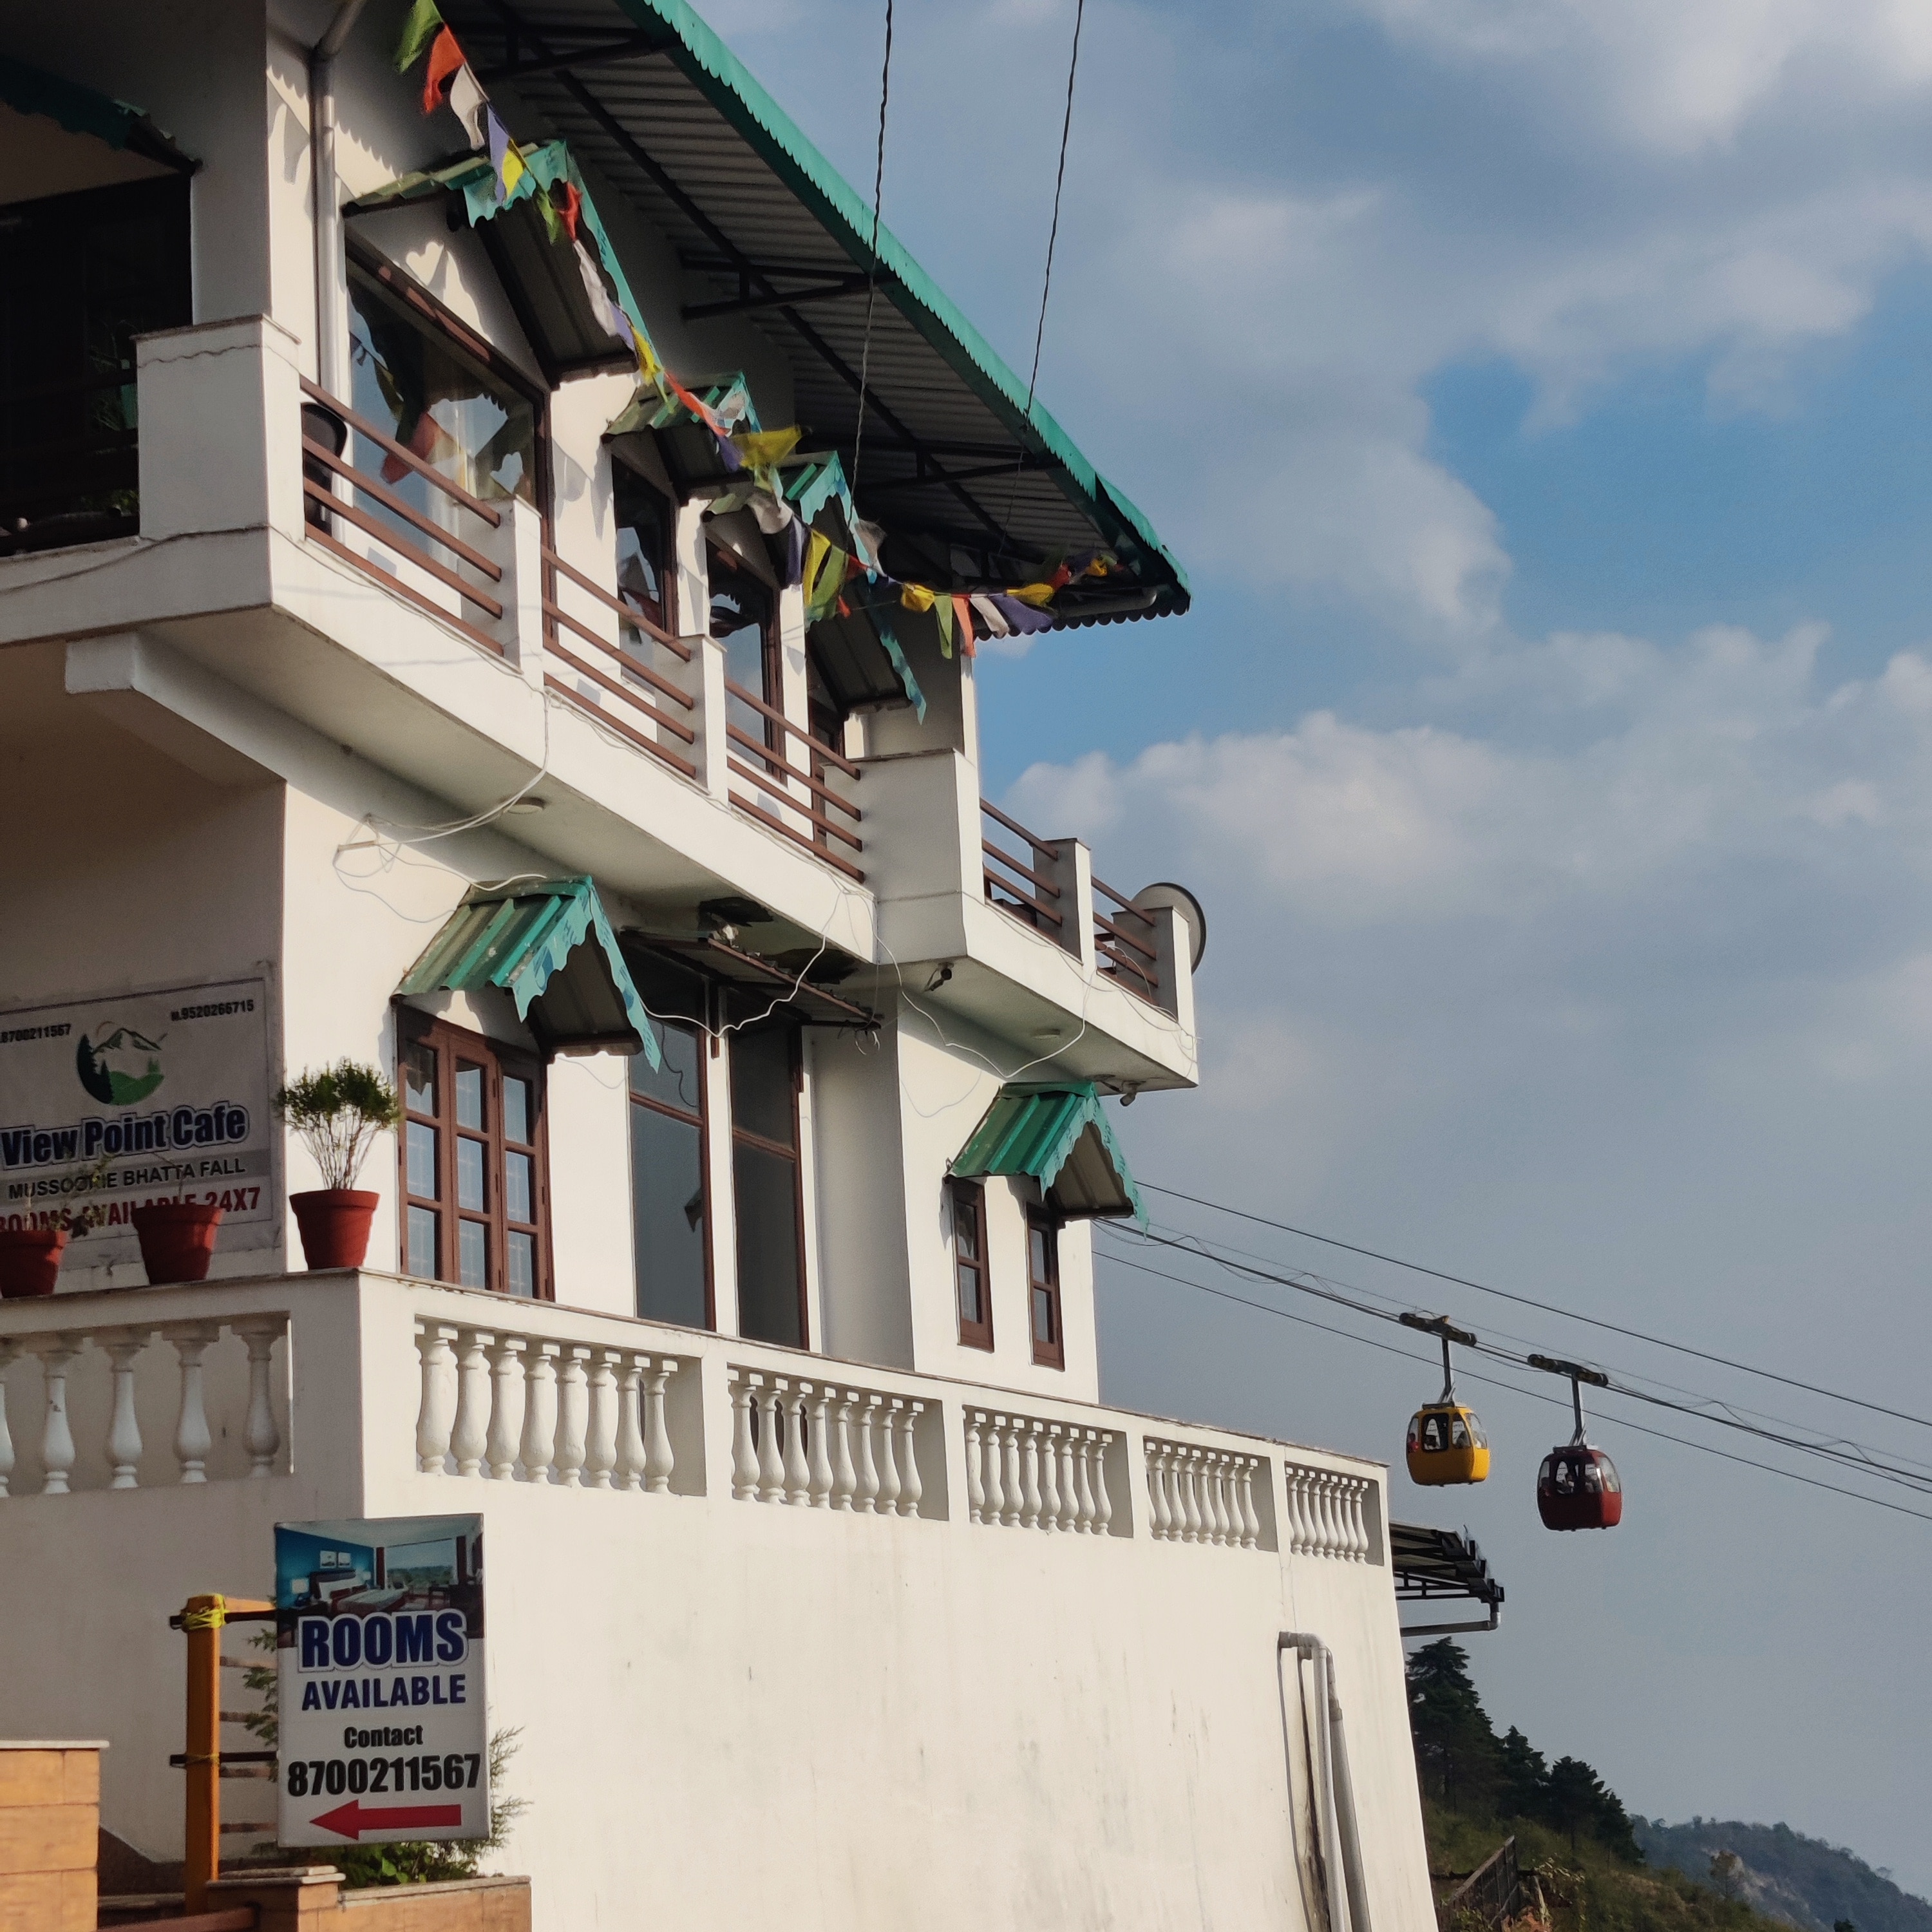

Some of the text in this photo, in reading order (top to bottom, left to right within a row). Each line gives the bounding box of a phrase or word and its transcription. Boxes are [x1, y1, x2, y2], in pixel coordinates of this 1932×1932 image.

[1, 1104, 245, 1166] View Point Cafe
[123, 1164, 195, 1186] BHATTA
[200, 1158, 245, 1176] FALL
[301, 1612, 466, 1669] ROOMS
[301, 1674, 466, 1711] AVAILABLE
[343, 1725, 424, 1748] Contact
[287, 1753, 481, 1797] 8700211567
